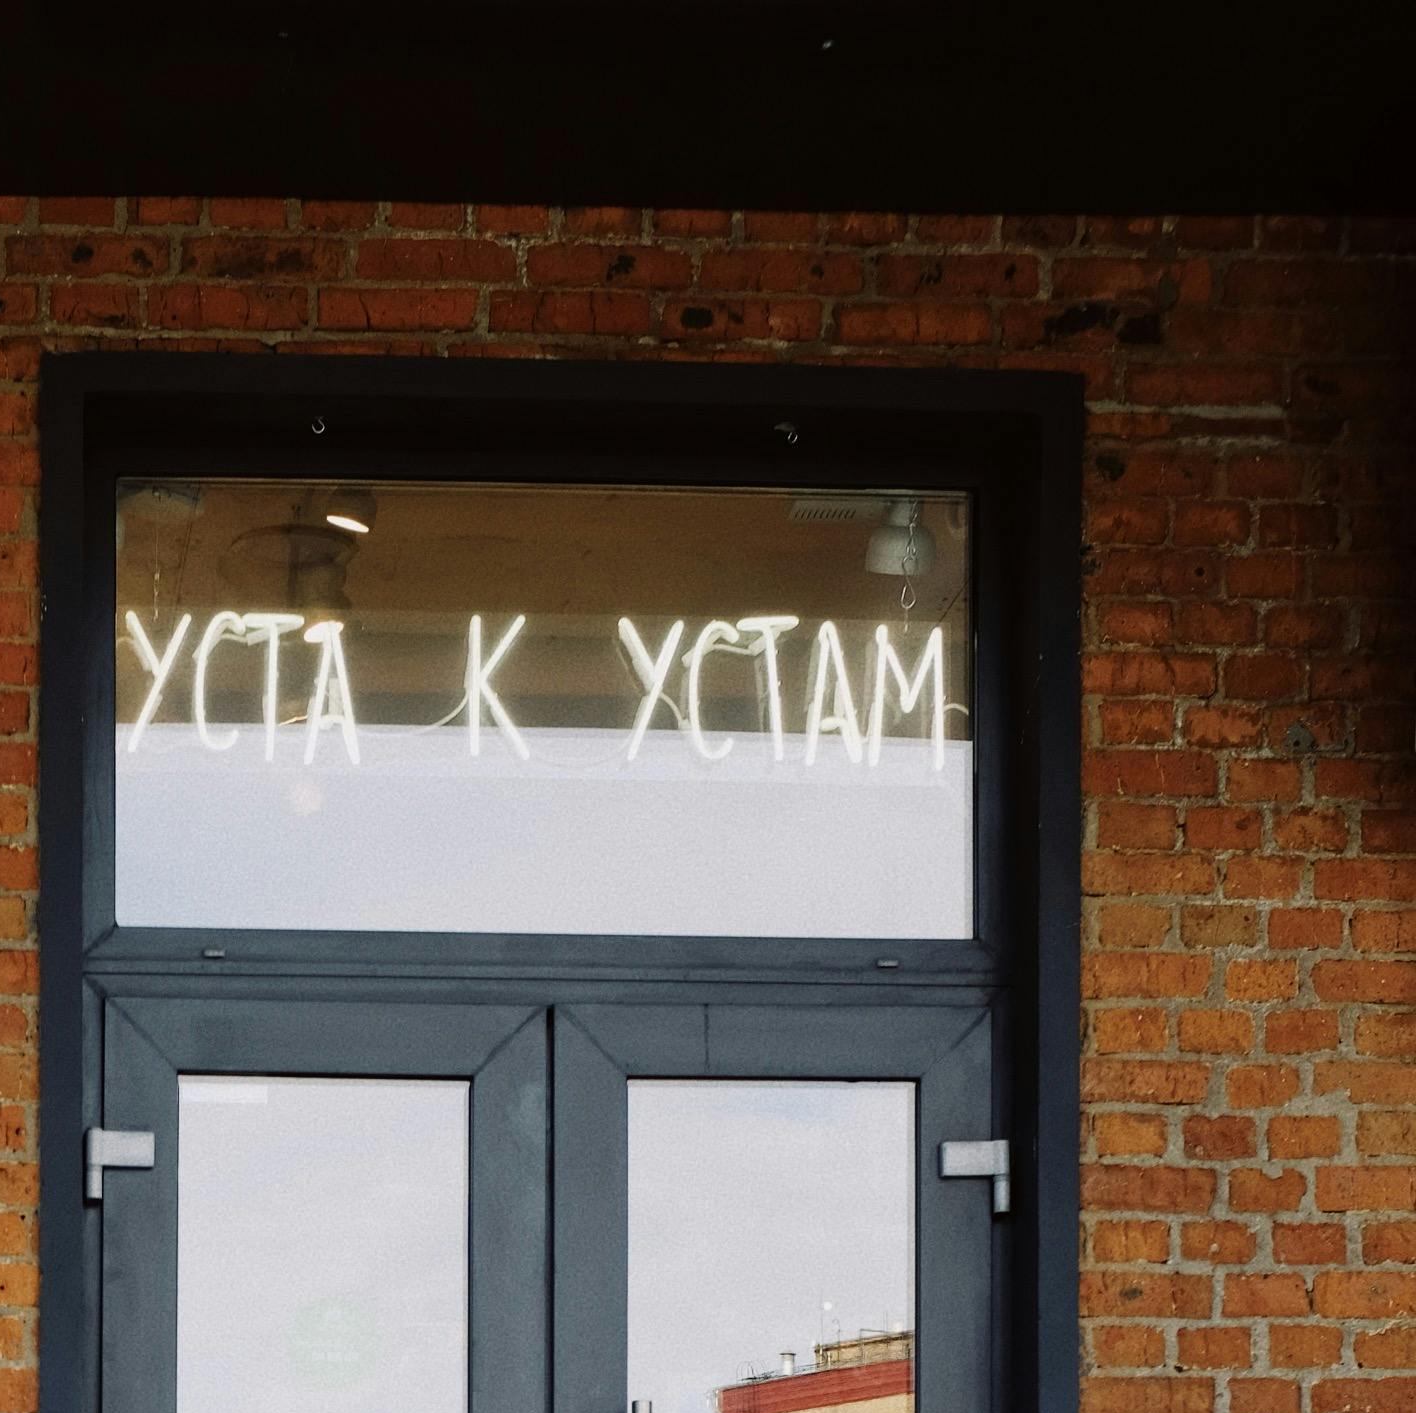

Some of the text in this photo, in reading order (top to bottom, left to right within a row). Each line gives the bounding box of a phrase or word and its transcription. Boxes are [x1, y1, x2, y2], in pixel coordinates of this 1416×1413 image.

[125, 611, 946, 771] УСТА К УСТАМ
